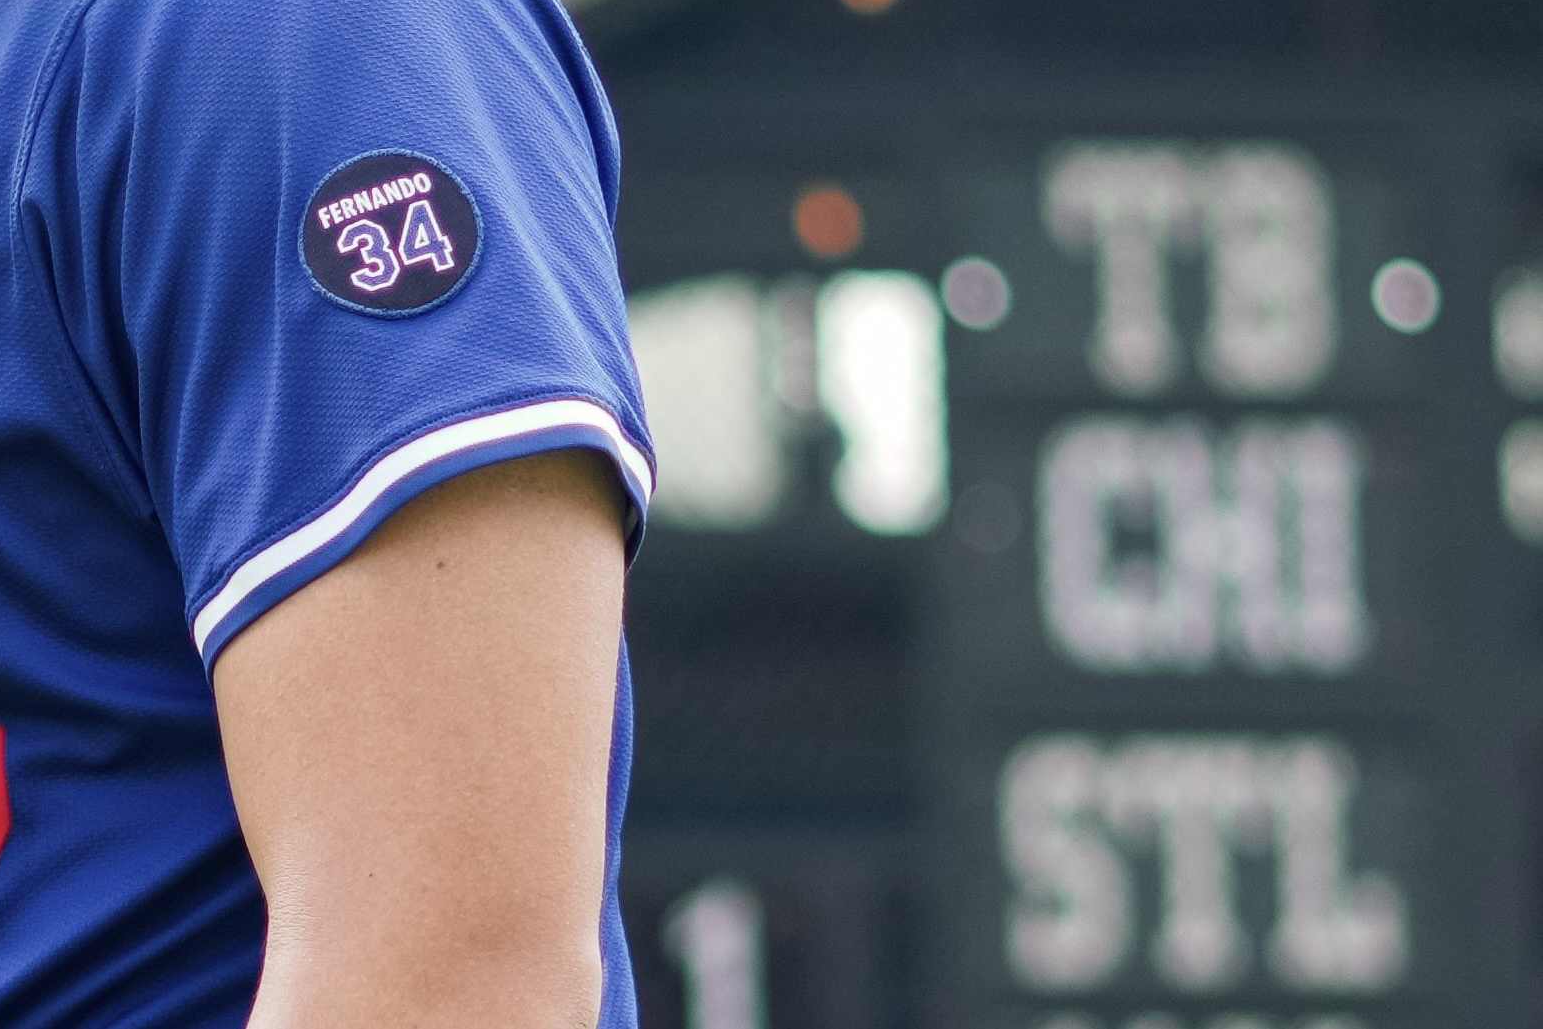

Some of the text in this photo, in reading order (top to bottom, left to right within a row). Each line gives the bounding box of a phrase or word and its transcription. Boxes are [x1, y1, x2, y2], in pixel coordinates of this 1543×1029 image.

[318, 173, 432, 229] FERNANDO
[337, 200, 455, 291] 34
[1044, 141, 1336, 397] TB
[1038, 419, 1368, 671] CHI
[1000, 735, 1407, 990] STL
